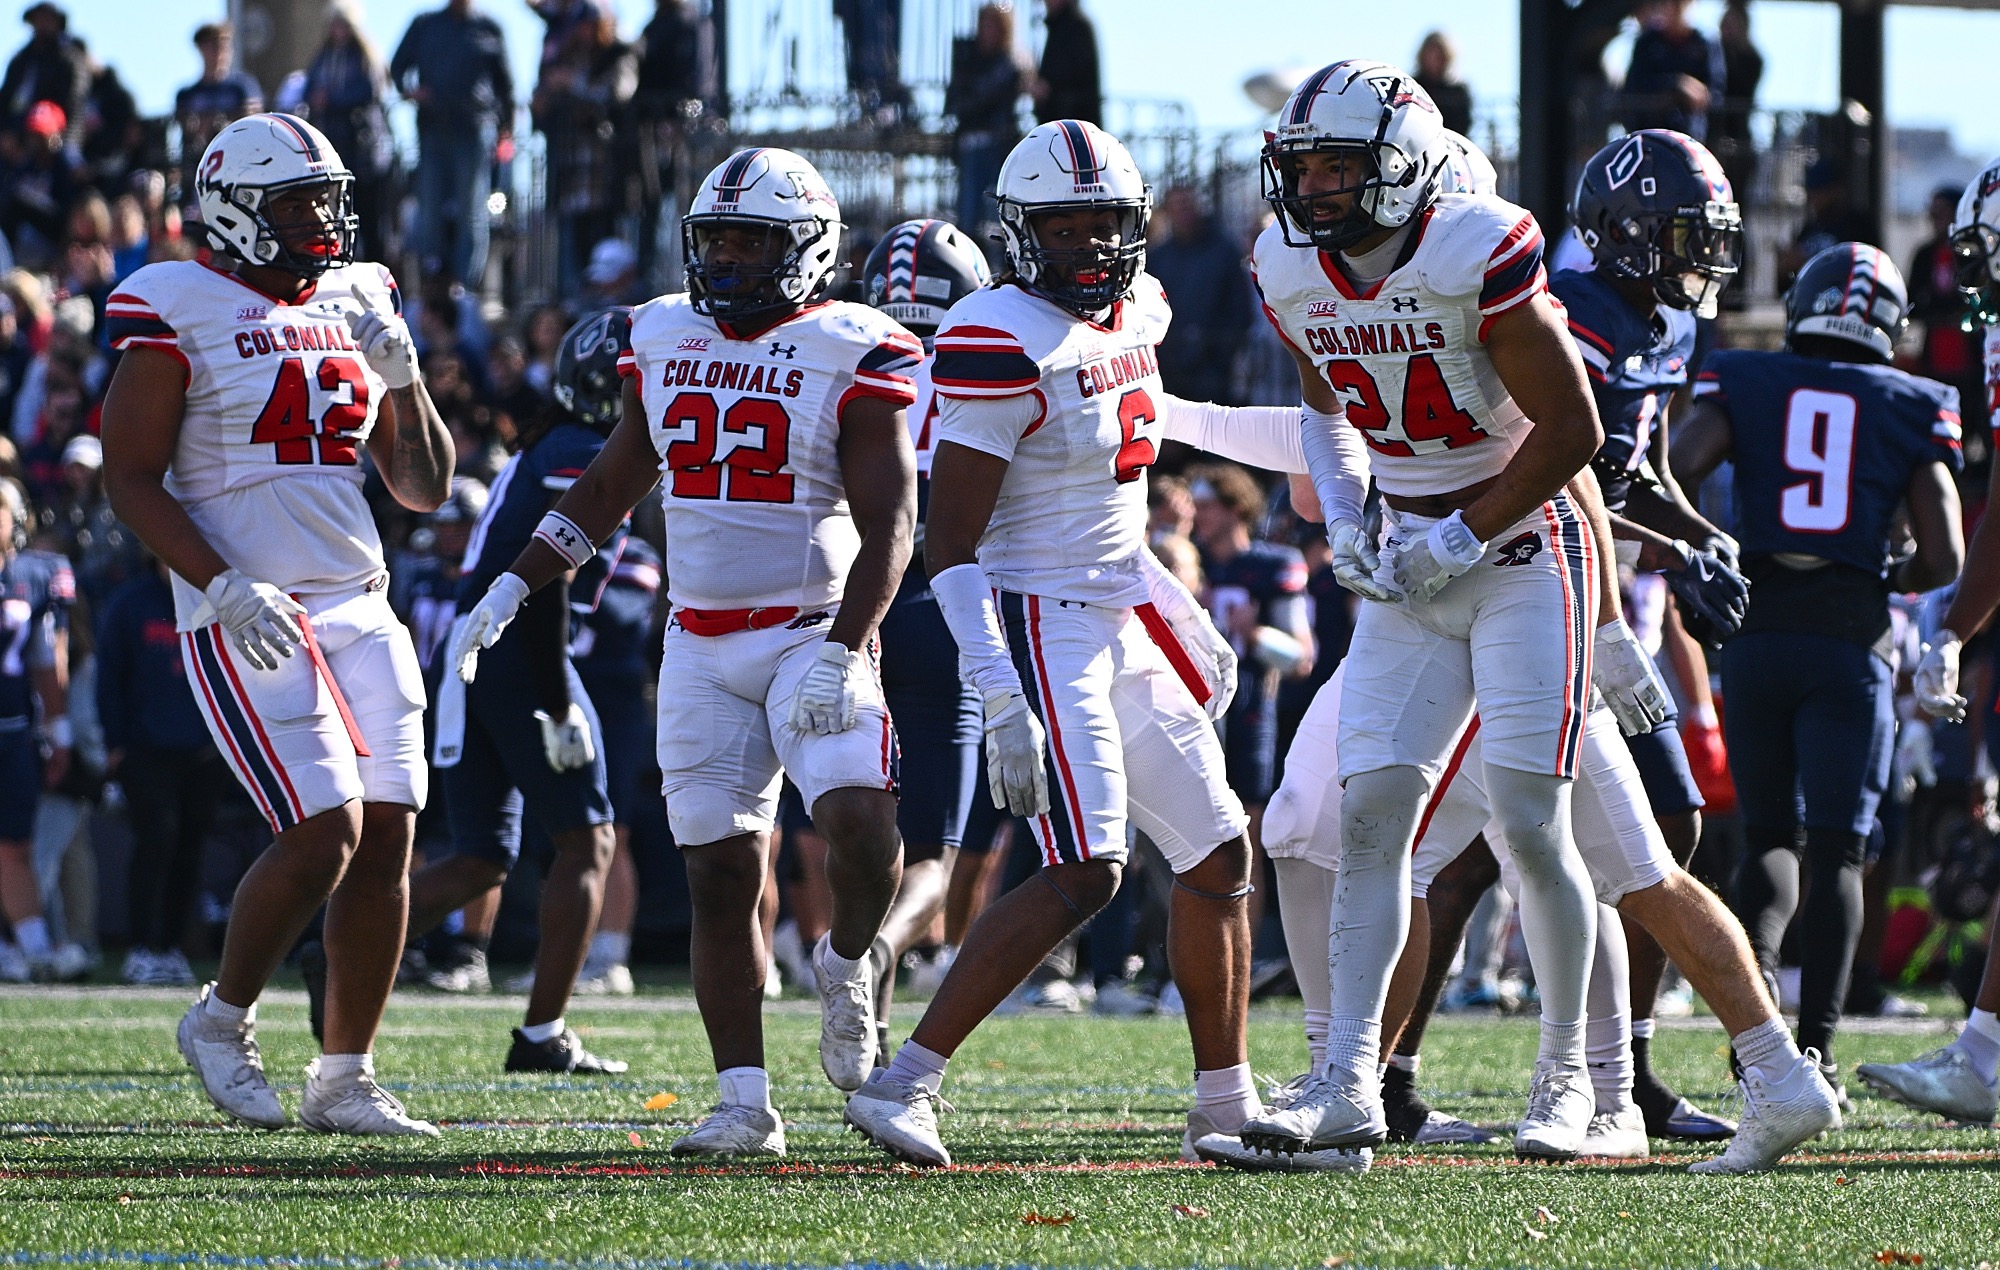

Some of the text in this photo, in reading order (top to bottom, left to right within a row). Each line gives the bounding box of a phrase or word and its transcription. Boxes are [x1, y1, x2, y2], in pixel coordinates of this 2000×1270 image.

[1074, 185, 1105, 194] UNITE
[711, 204, 739, 212] UNITE
[237, 306, 266, 320] NEC
[1308, 301, 1337, 315] NEC
[235, 325, 362, 359] COLONIAL
[677, 338, 712, 350] NEC
[1305, 322, 1446, 355] COLONIALS
[663, 360, 804, 398] COLONIALS
[1076, 345, 1158, 398] COLONIAL
[250, 357, 369, 465] 42
[1327, 353, 1490, 457] 24
[662, 392, 795, 504] 22
[1114, 386, 1156, 485] 6
[1779, 387, 1860, 535] 9
